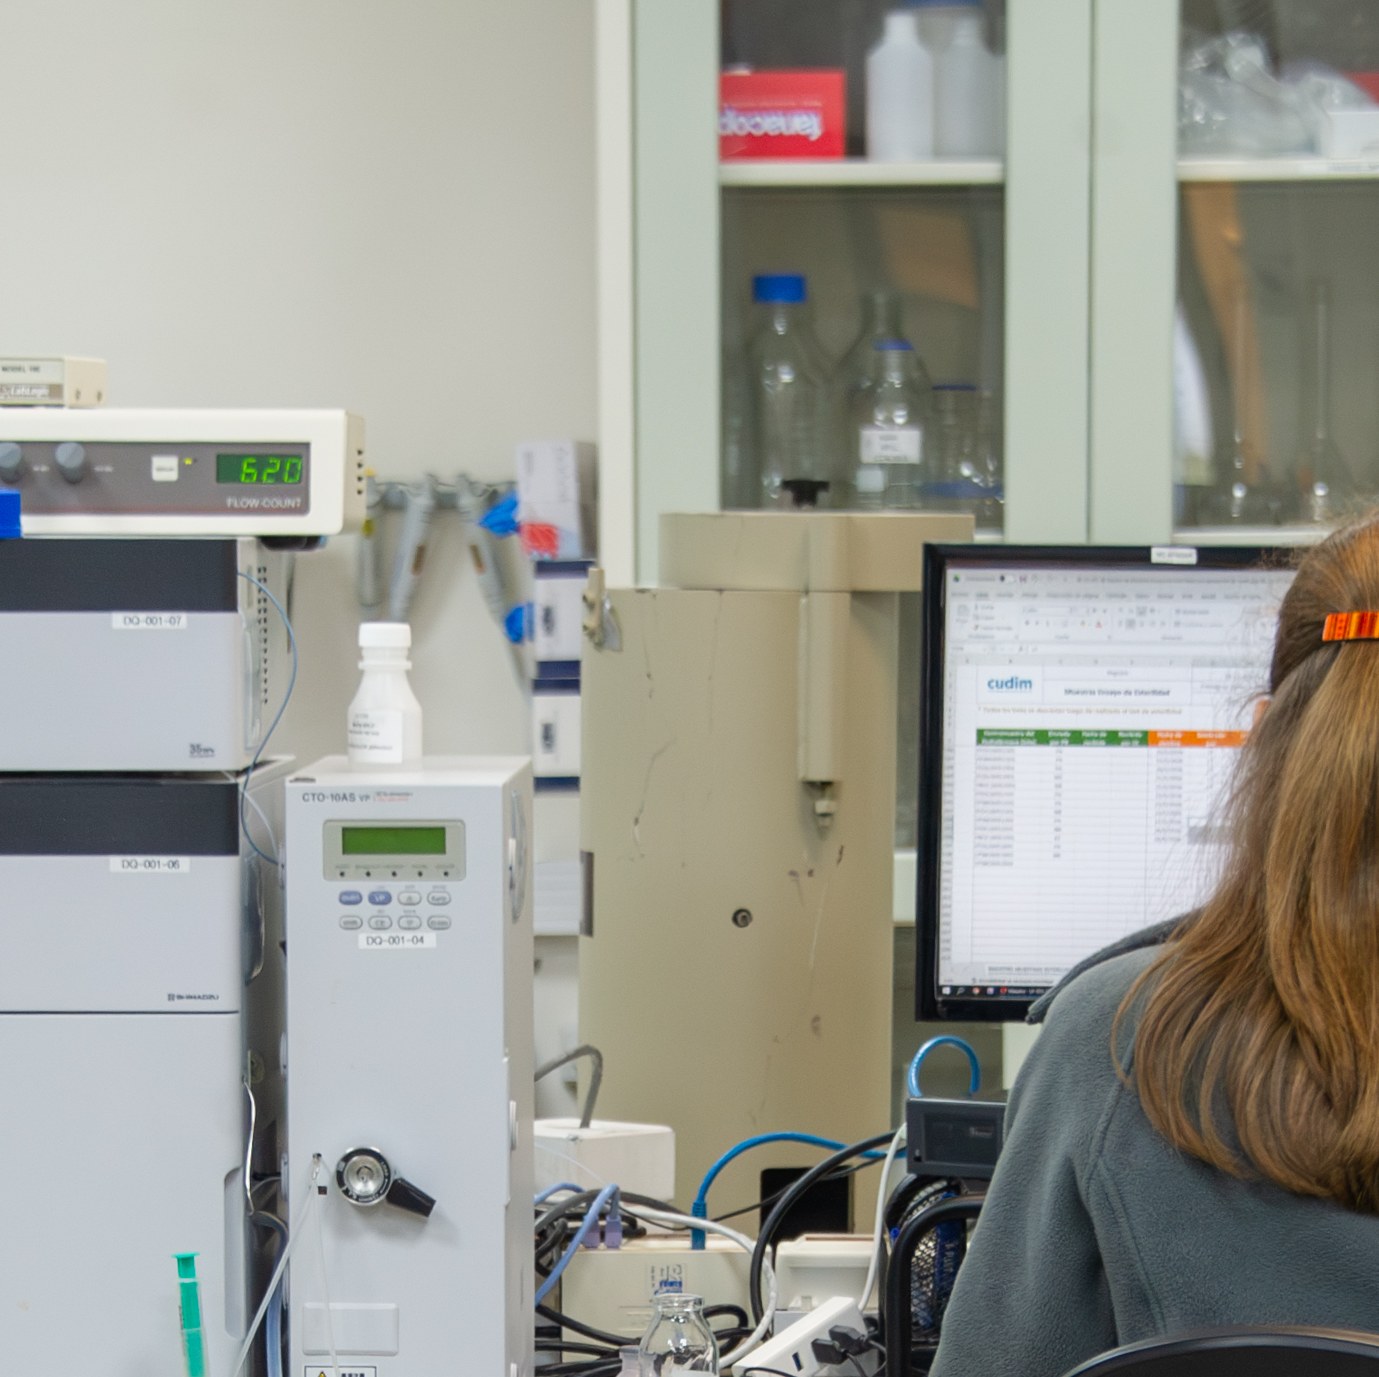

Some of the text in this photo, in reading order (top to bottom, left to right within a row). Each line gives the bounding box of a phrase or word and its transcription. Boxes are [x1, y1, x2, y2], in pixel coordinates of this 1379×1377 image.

[240, 457, 301, 484] 620
[123, 615, 182, 626] DQ-001-07
[987, 676, 1032, 690] cudim
[302, 792, 356, 803] CTO-10AS
[359, 794, 371, 802] VP
[121, 859, 180, 870] DQ-001-06
[366, 935, 424, 946] DQ-001-04
